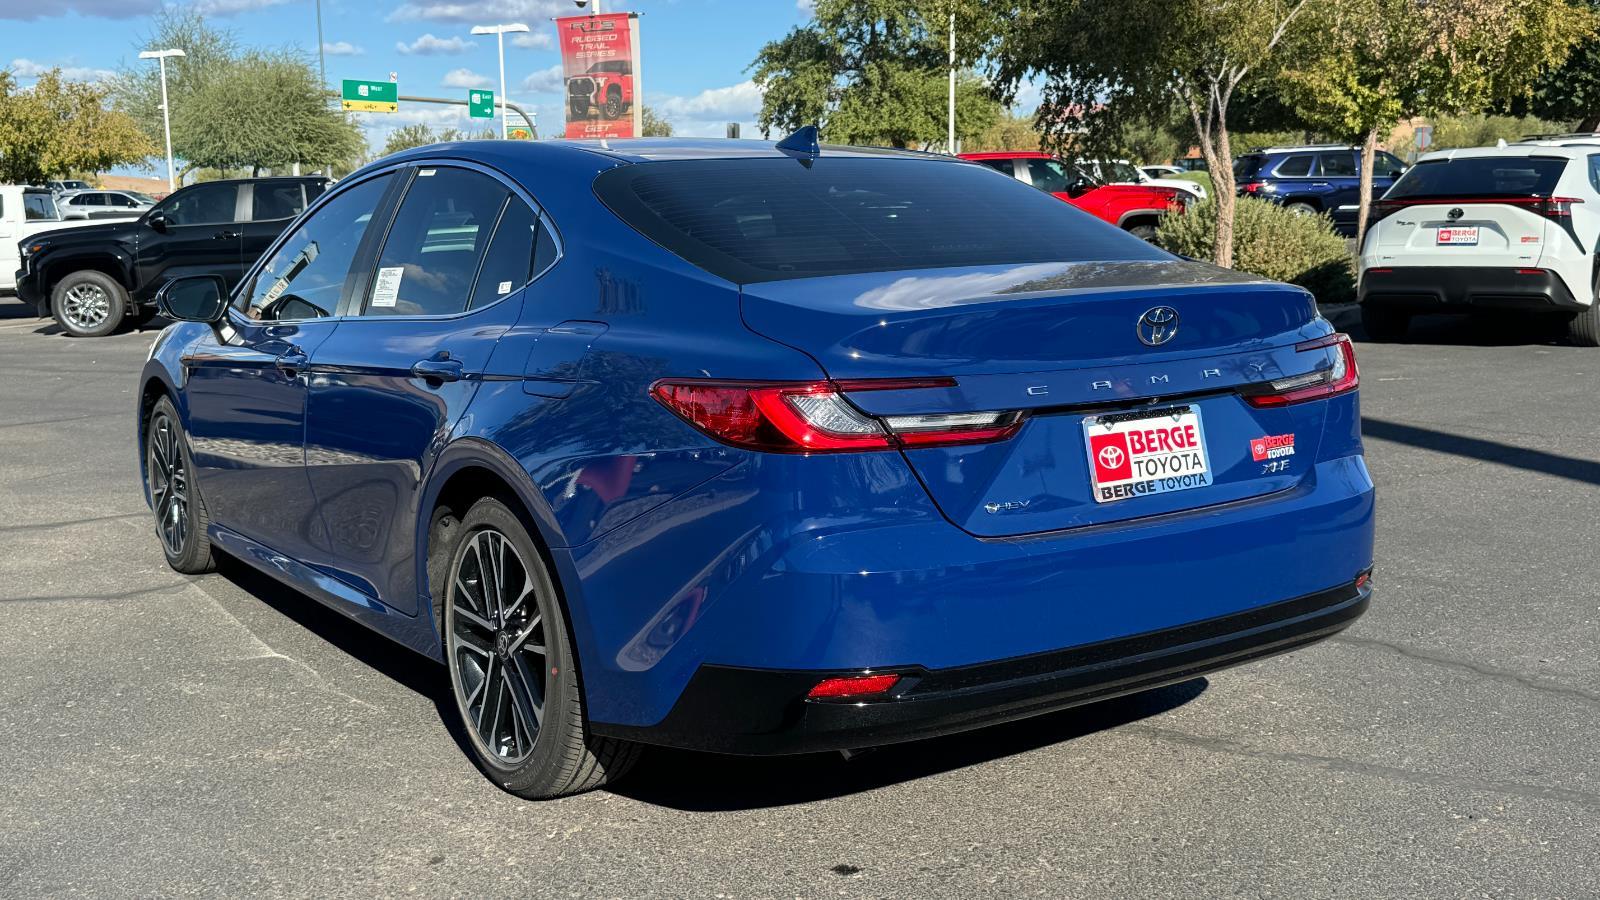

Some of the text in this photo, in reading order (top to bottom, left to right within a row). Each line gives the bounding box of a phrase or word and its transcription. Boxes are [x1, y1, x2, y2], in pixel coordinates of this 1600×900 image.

[571, 34, 617, 44] RUGGED
[575, 50, 616, 58] SERIES
[580, 43, 610, 51] TRAIL
[585, 124, 612, 133] GET
[1452, 229, 1477, 237] BERGE
[1026, 361, 1265, 396] CAMRY
[1128, 425, 1197, 455] BERGE
[1264, 433, 1295, 449] BERGE
[1267, 446, 1295, 459] TOYOTA
[1134, 453, 1203, 477] TOYOTA
[1159, 473, 1207, 491] TOYOTA
[1101, 480, 1156, 500] BERGE
